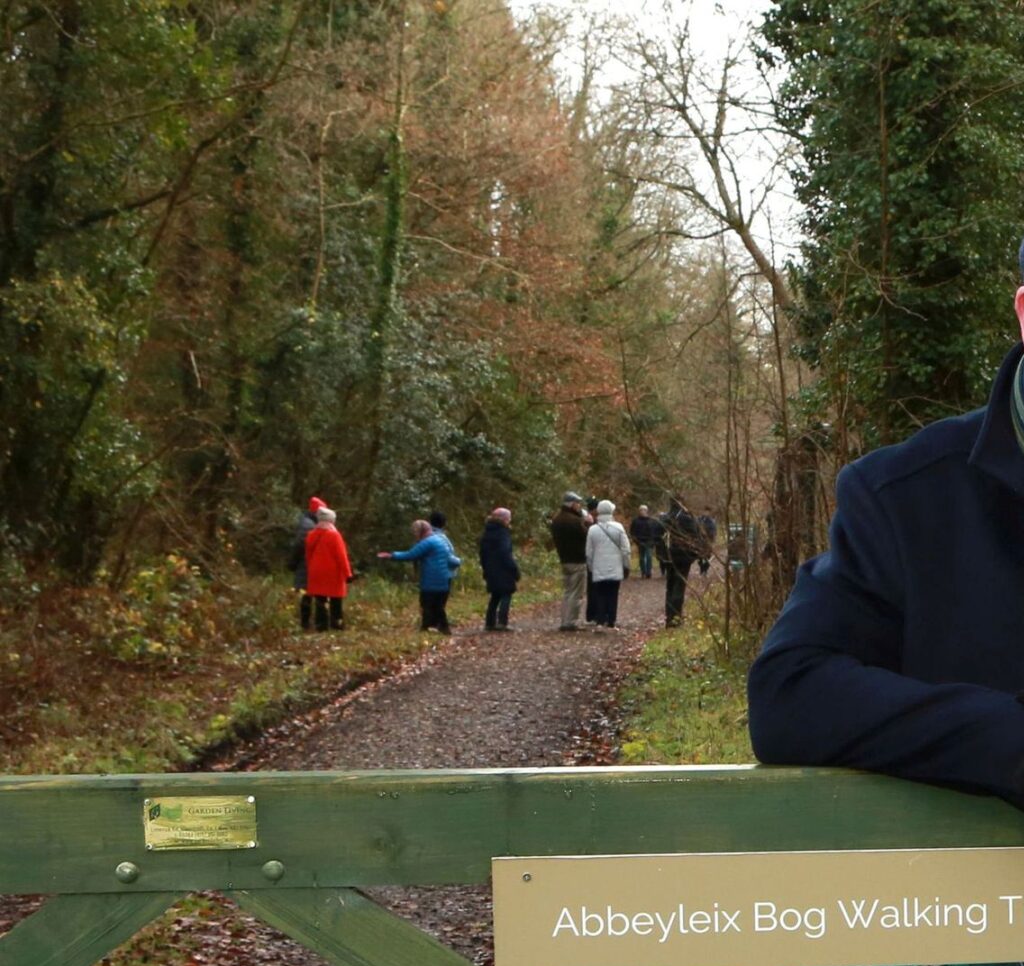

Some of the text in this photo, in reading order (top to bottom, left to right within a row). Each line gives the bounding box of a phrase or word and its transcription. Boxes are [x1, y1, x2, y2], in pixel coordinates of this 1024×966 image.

[552, 902, 741, 943] Abbeyleix
[754, 902, 826, 939] Bog
[837, 896, 987, 934] Walking
